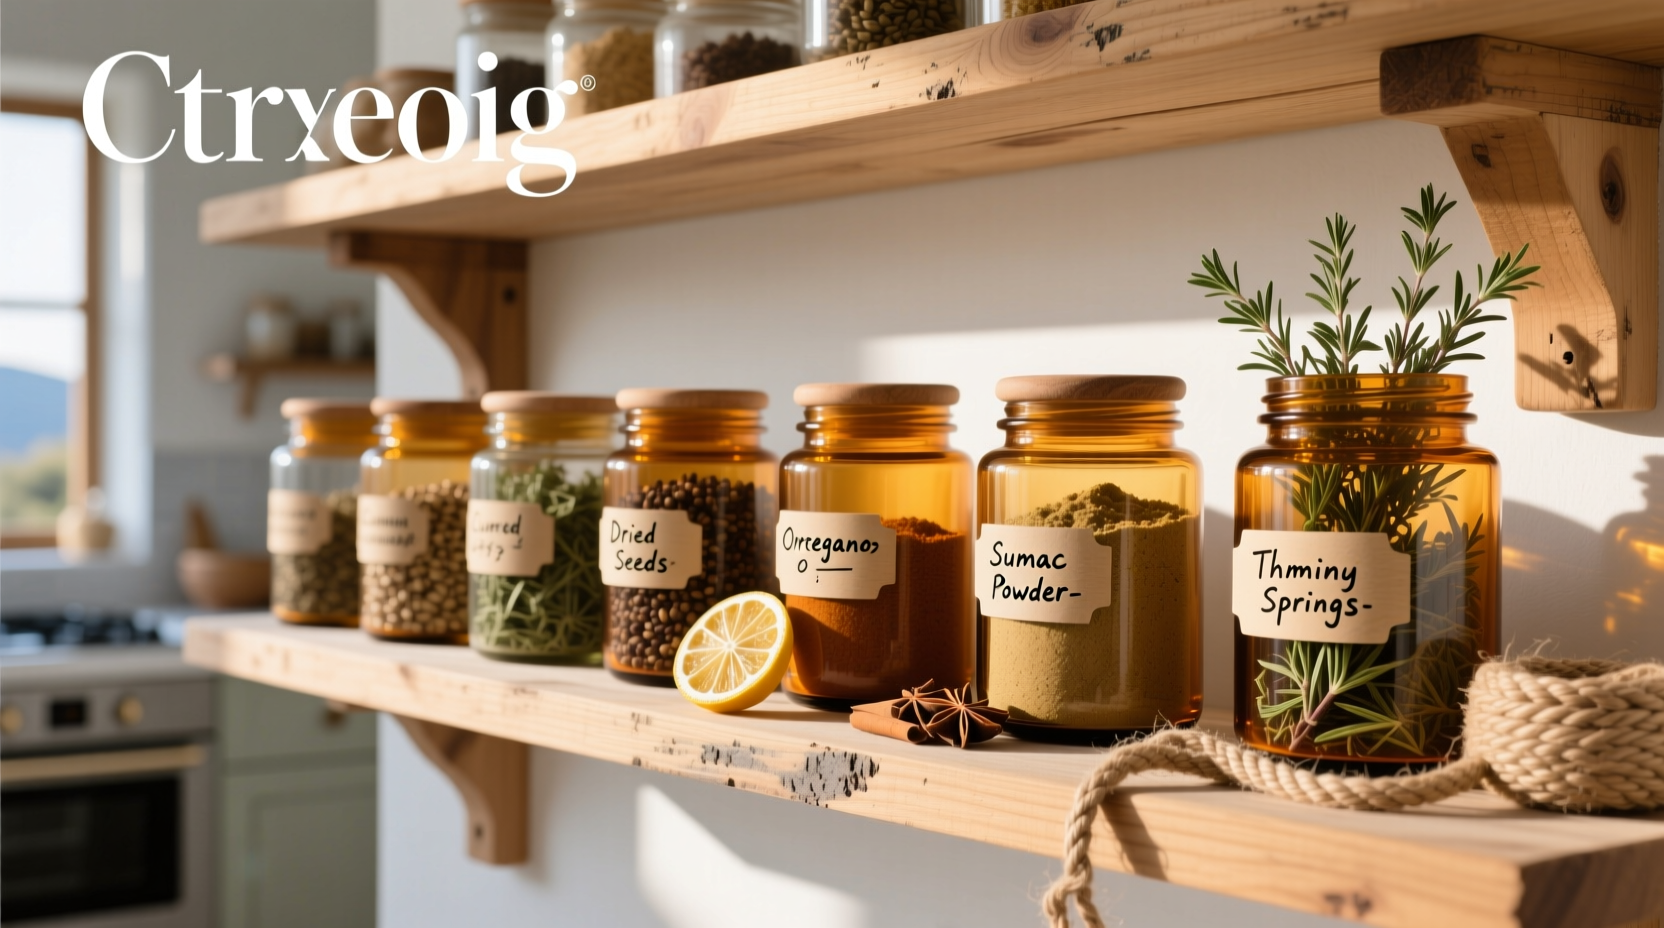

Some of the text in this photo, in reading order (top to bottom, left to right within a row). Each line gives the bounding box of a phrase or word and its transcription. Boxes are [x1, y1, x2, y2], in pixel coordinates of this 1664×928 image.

[610, 519, 657, 544] Dried
[989, 540, 1068, 570] Sumac
[1252, 548, 1357, 593] Thminy
